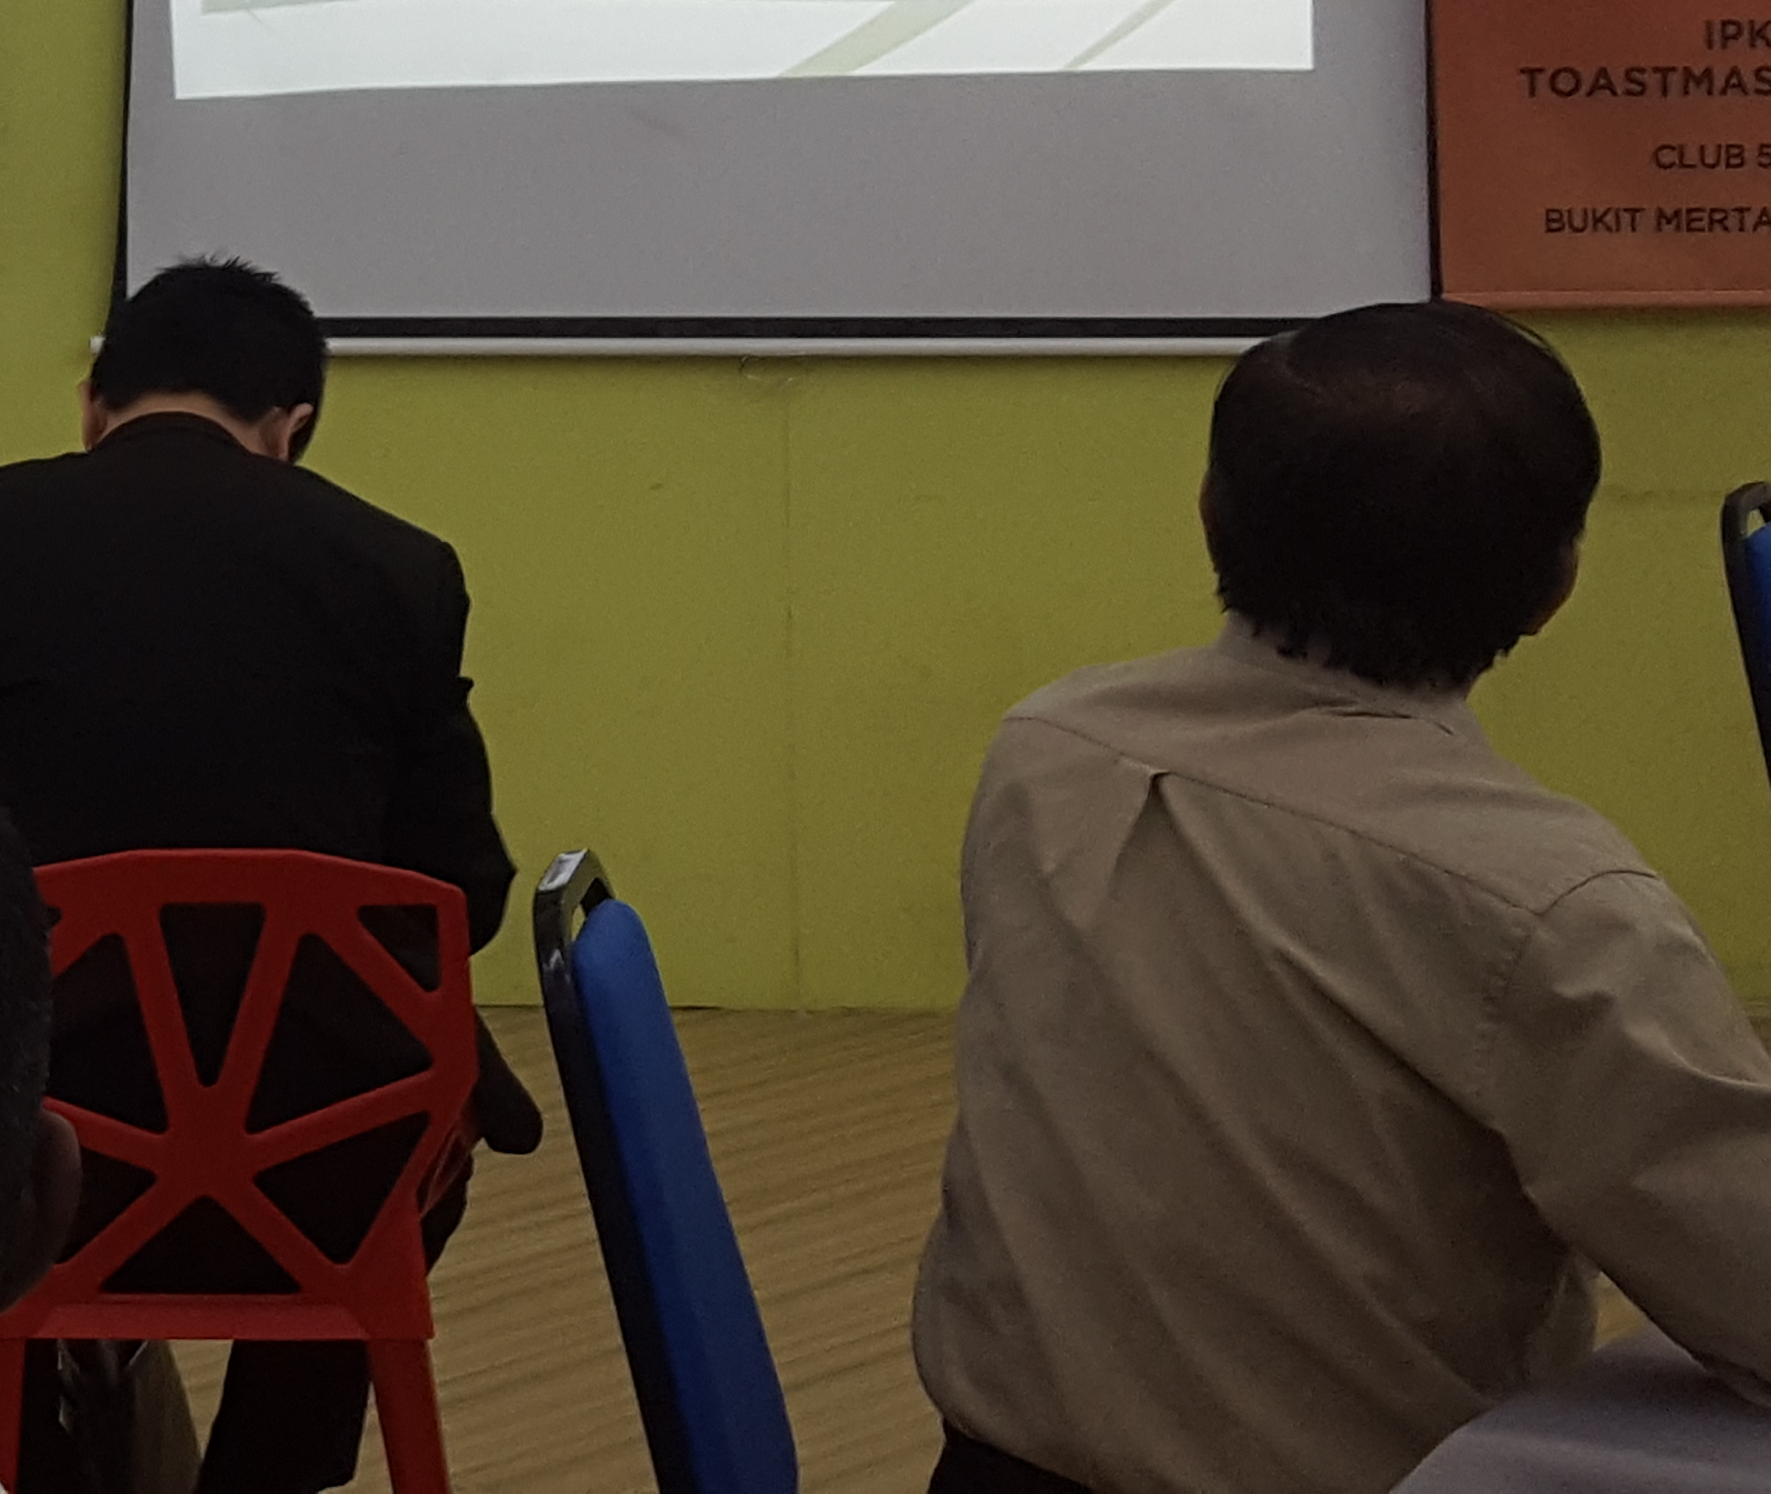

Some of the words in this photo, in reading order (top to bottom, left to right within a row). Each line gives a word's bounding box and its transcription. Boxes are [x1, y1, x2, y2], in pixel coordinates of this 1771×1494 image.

[1704, 19, 1771, 50] IPK
[1518, 66, 1771, 98] TOASTMAS
[1653, 143, 1746, 170] CLUB
[1544, 207, 1646, 234] BUKIT
[1655, 206, 1771, 233] MERTA
